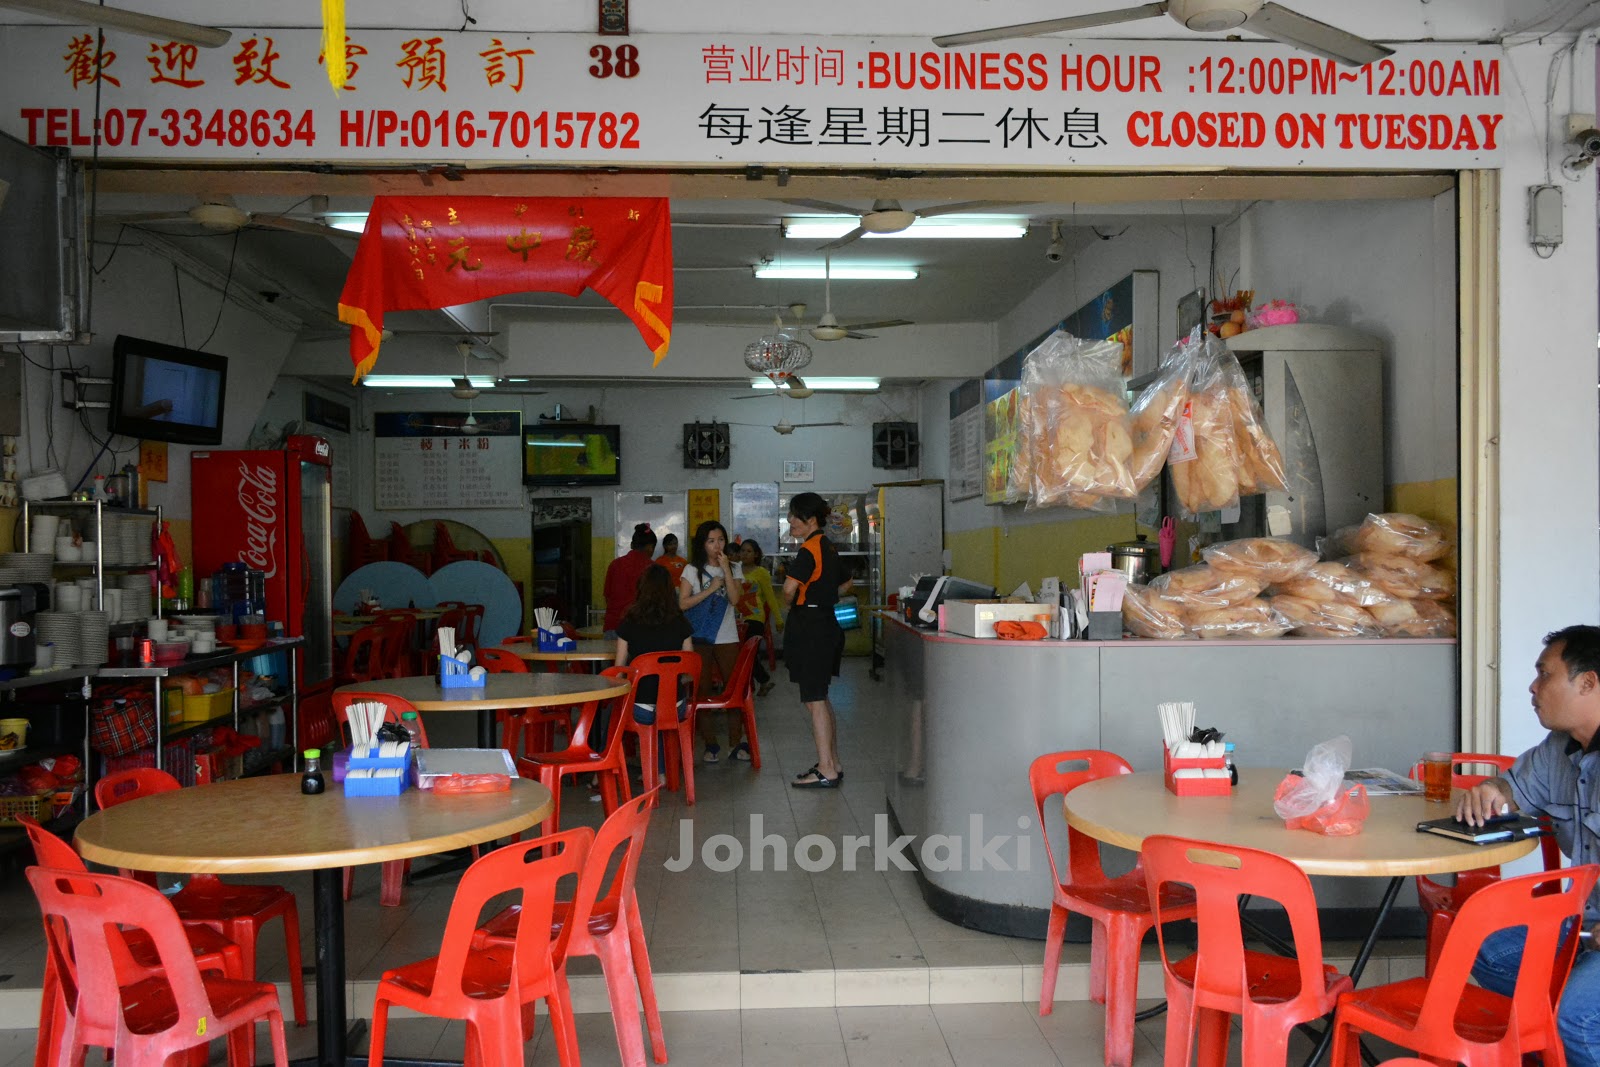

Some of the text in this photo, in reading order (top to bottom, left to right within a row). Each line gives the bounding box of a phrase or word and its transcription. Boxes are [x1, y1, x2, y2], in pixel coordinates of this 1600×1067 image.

[589, 45, 640, 79] 38
[702, 44, 845, 86] 营业时间
[1060, 53, 1163, 93] HOUR
[21, 107, 641, 149] TEL:07-3348634 H/P:016-7015782
[698, 102, 1109, 148] 每逢星期二休息
[1126, 109, 1504, 151] CLOSED ON TUESDAY
